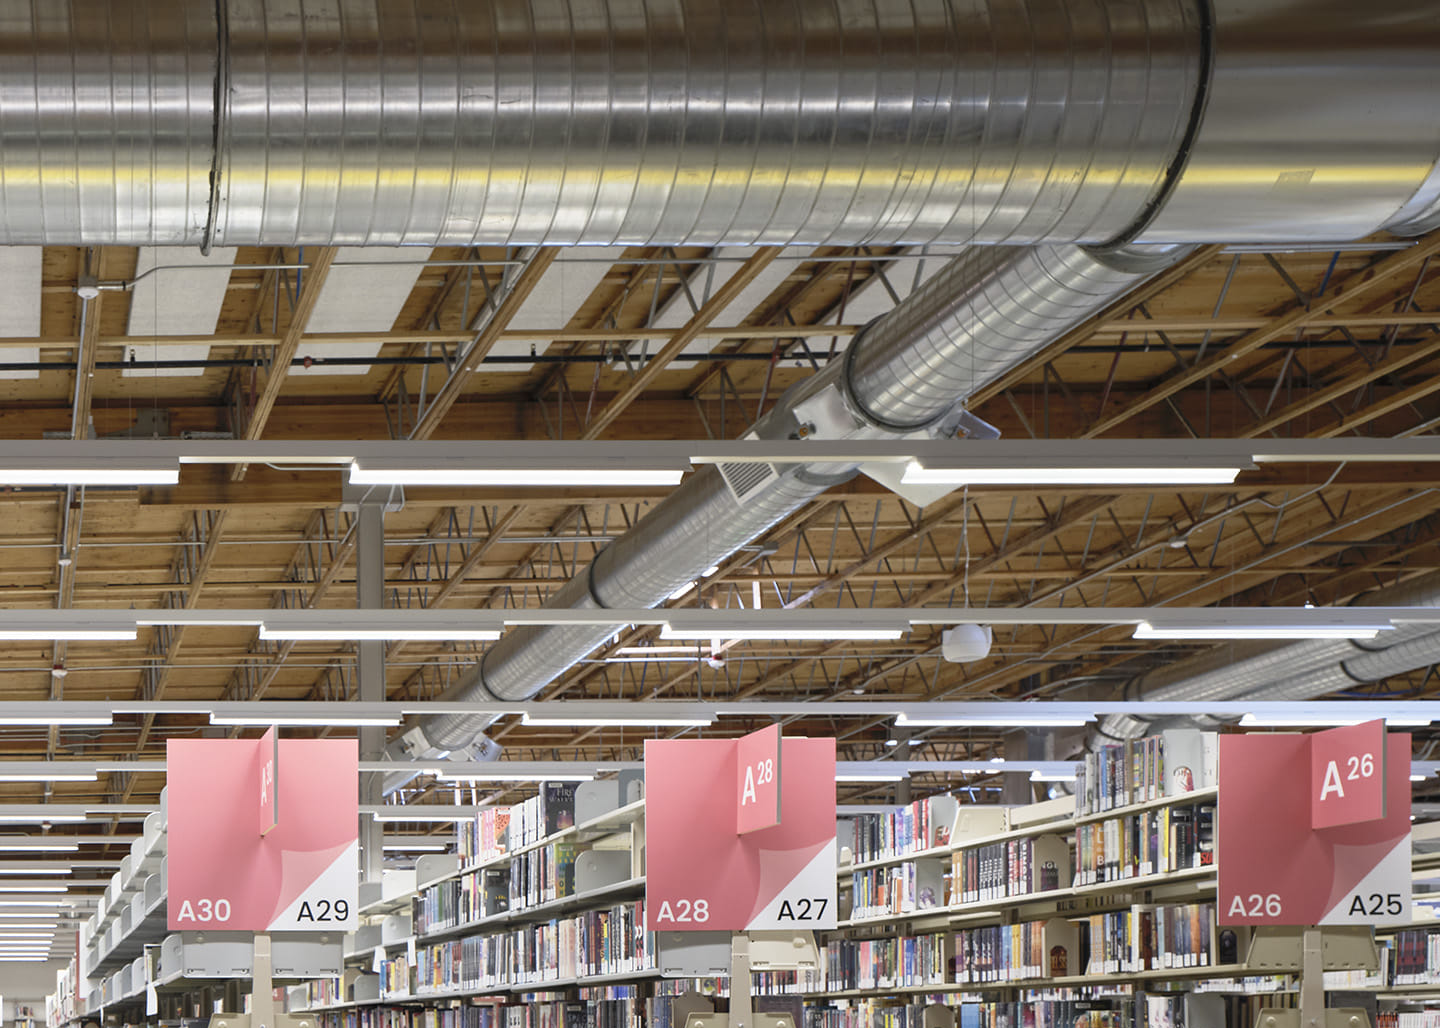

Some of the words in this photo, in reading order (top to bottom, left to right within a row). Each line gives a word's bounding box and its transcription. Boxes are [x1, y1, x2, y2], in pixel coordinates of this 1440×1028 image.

[177, 899, 231, 922] A30
[297, 899, 349, 922] A29
[657, 899, 709, 922] A28
[777, 898, 828, 921] A27
[1228, 894, 1282, 917] A26
[1348, 893, 1402, 916] A25
